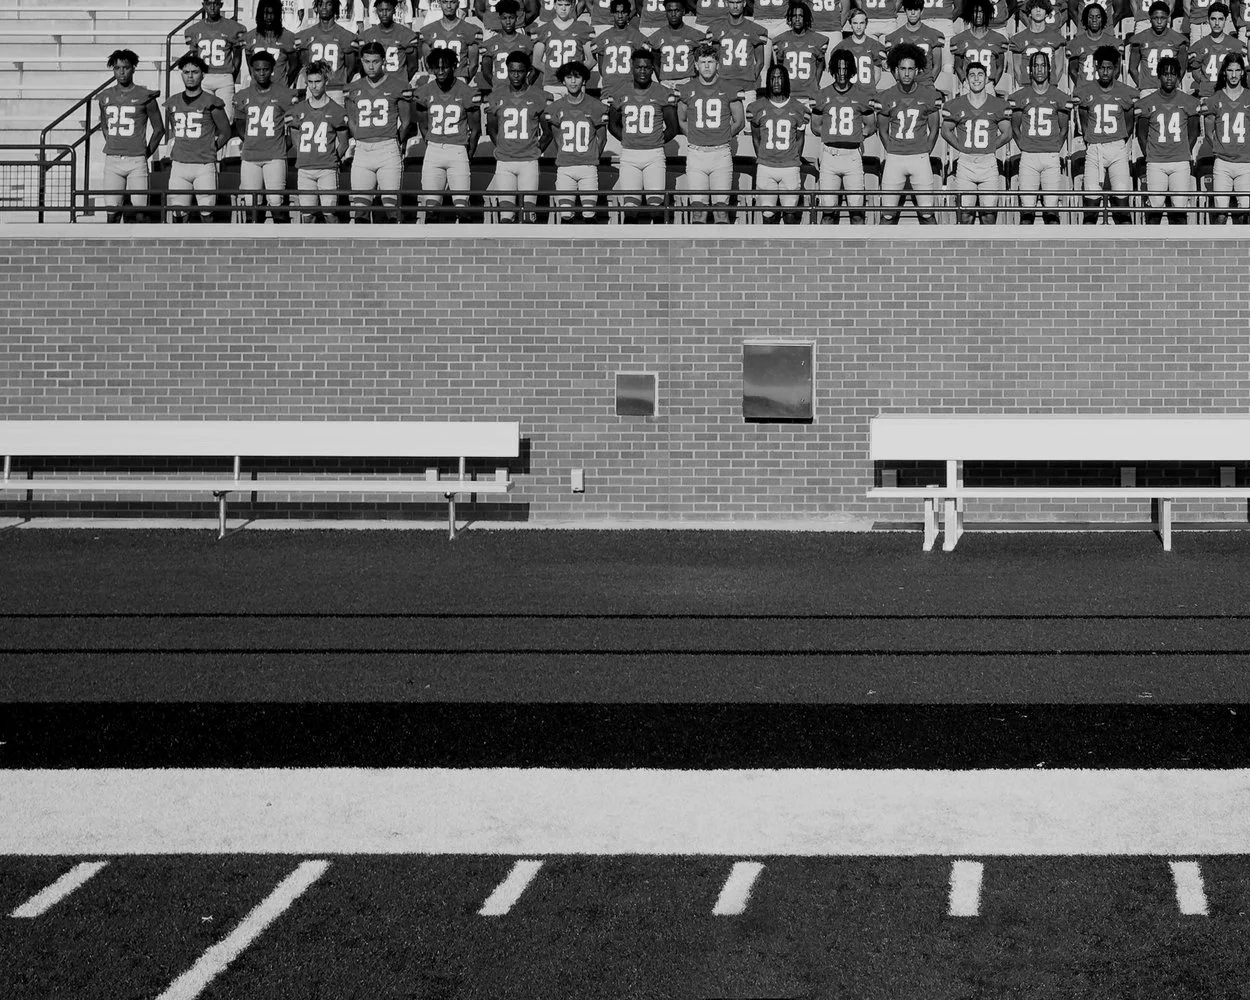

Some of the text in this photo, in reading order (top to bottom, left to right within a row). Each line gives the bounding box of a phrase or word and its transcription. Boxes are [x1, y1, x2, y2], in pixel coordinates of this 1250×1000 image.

[198, 39, 226, 66] 26
[311, 43, 338, 72] 29
[549, 40, 577, 68] 32
[606, 46, 631, 74] 33
[662, 45, 689, 72] 33
[721, 38, 747, 66] 34
[786, 51, 812, 79] 35
[106, 106, 135, 136] 25
[247, 106, 274, 136] 24
[357, 99, 388, 127] 23
[430, 105, 460, 134] 22
[504, 108, 528, 139] 21
[625, 105, 655, 133] 20
[695, 99, 721, 128] 19
[829, 107, 854, 135] 18
[896, 109, 919, 139] 17
[1028, 107, 1053, 136] 15
[1094, 104, 1118, 134] 15
[1157, 112, 1181, 142] 14
[1222, 112, 1245, 143] 14
[300, 122, 327, 152] 24
[561, 121, 590, 152] 20
[766, 119, 791, 150] 19
[964, 119, 989, 148] 16
